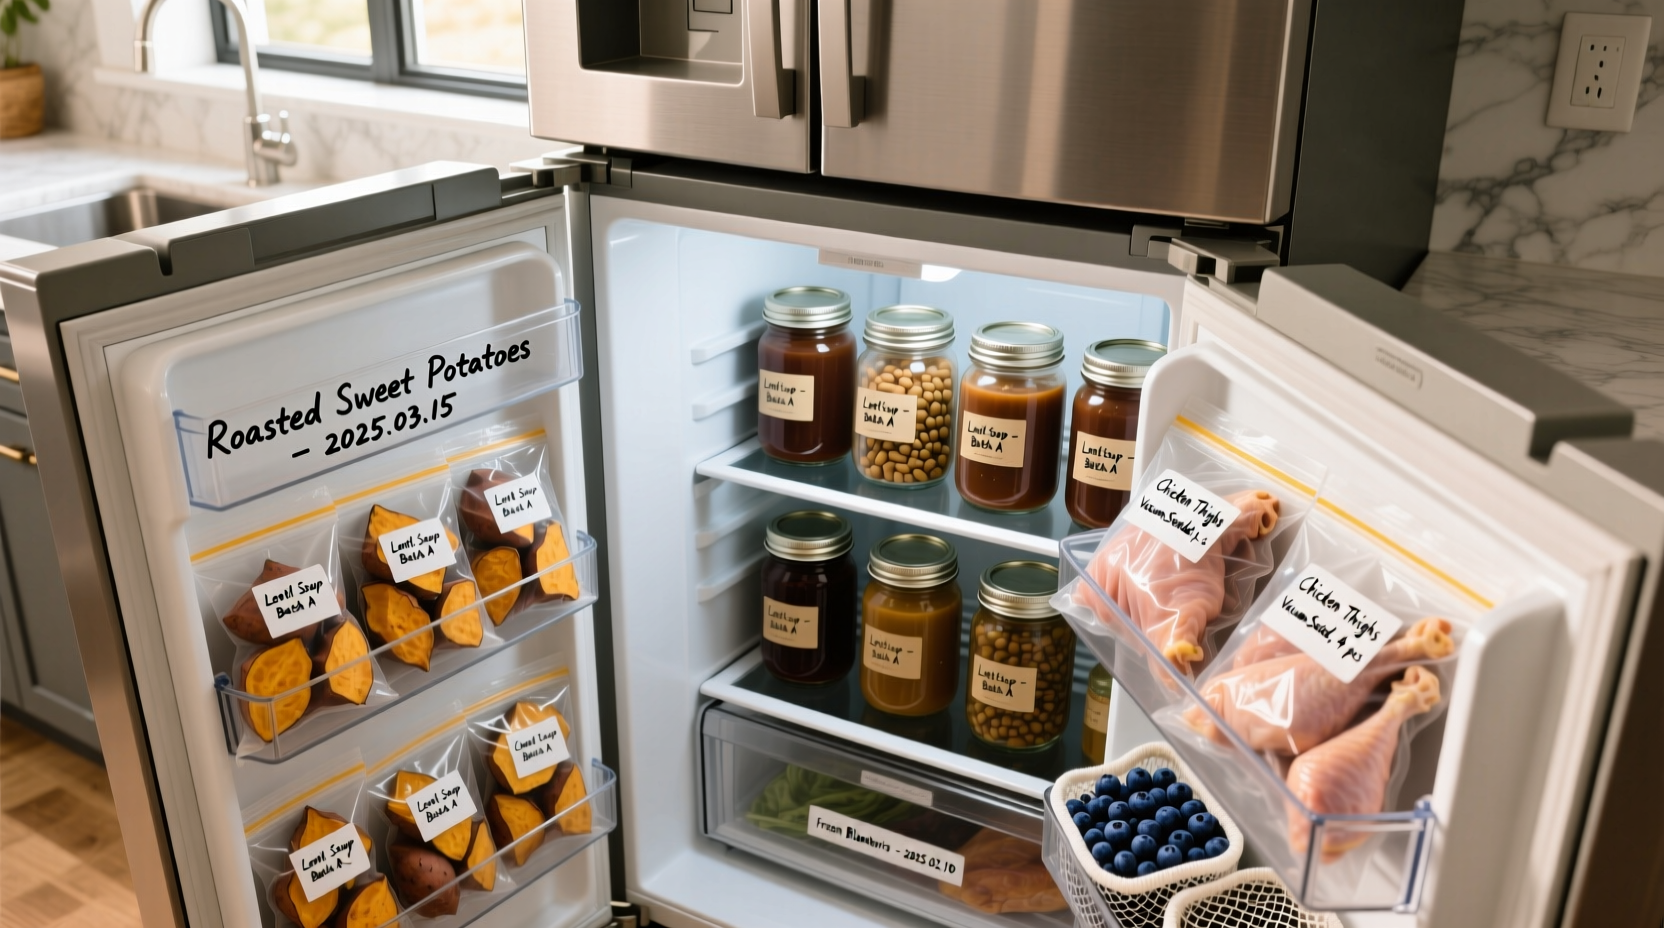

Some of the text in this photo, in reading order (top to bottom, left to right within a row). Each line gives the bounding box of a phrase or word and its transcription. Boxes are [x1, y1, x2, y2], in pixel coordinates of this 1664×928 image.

[207, 339, 531, 459] Roasted Sweet Potatoes
[324, 391, 457, 456] 2025.03.15
[1156, 478, 1224, 528] Chicken Thighs
[427, 544, 435, 557] A
[308, 595, 317, 609] A
[1299, 576, 1381, 641] Chicken Thighs
